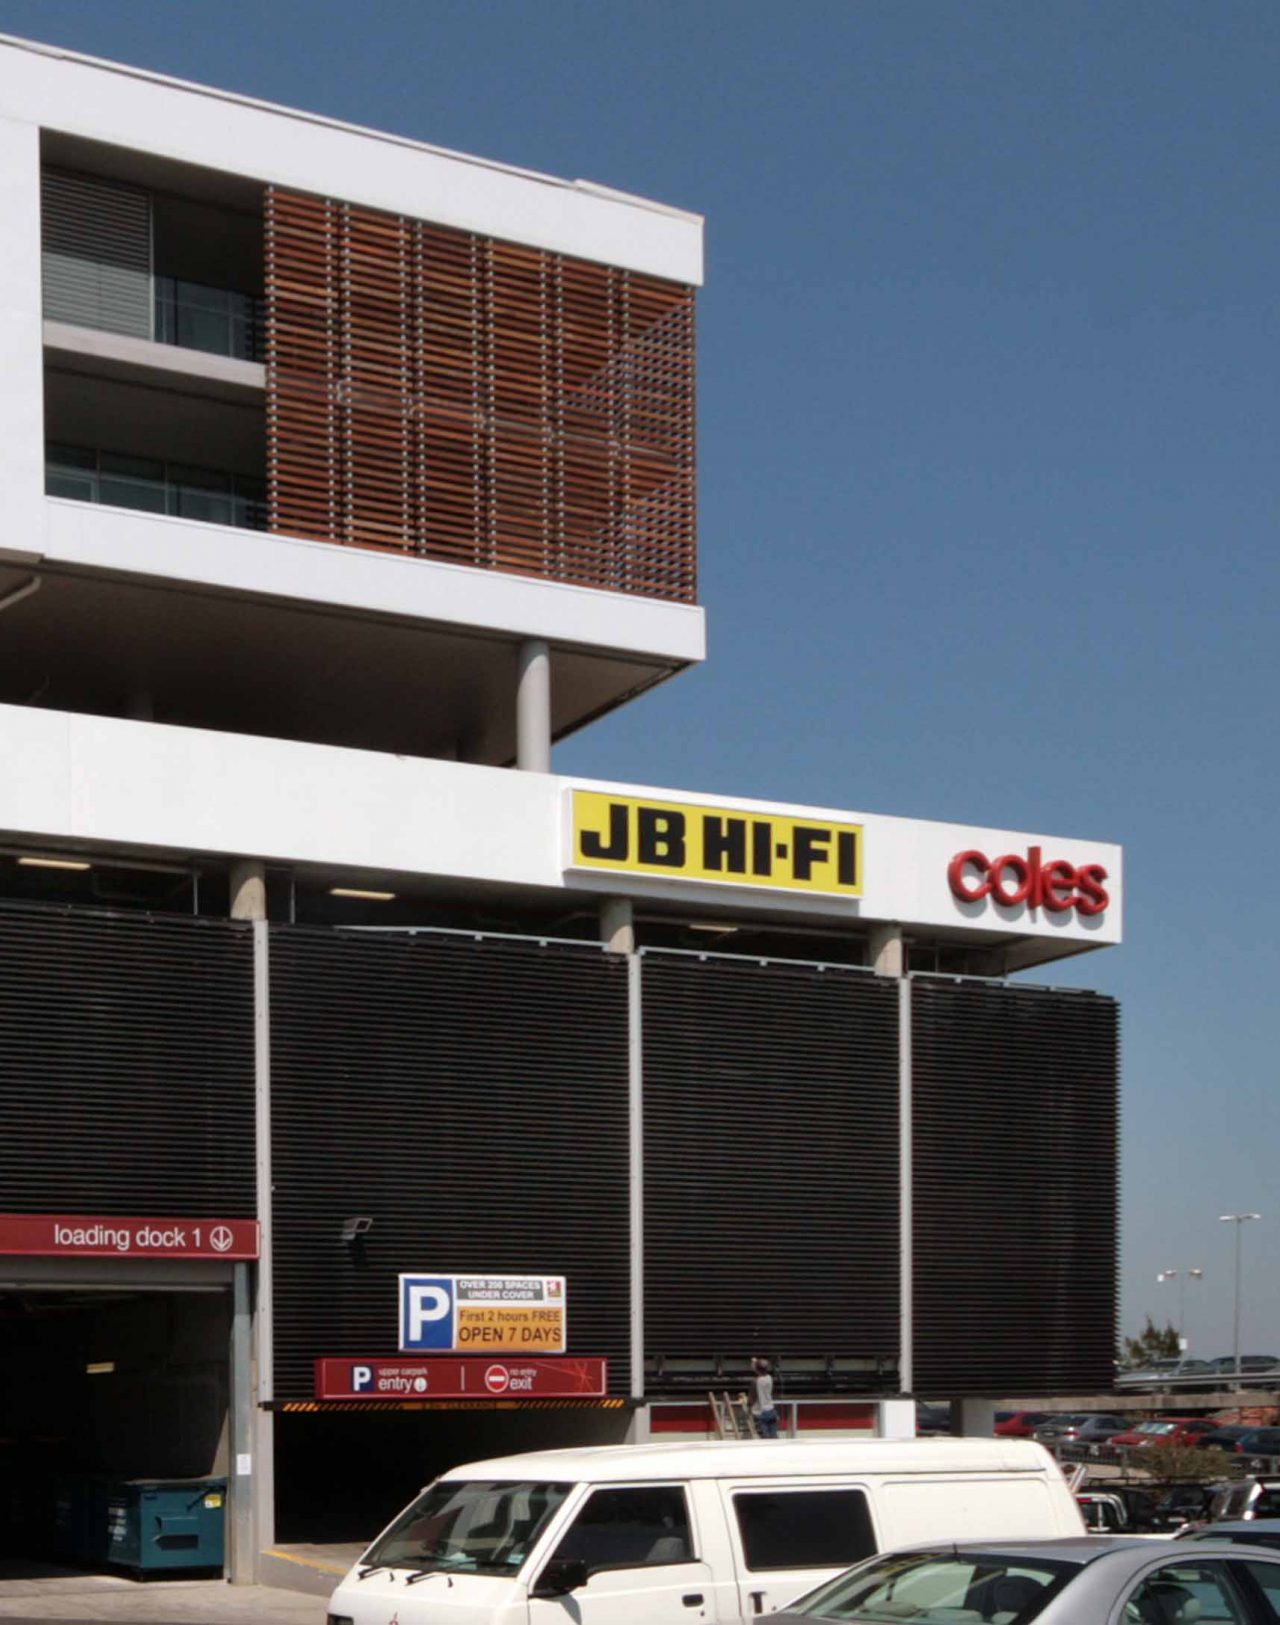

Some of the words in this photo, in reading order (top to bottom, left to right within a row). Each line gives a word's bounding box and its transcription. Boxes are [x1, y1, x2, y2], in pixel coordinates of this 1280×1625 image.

[580, 804, 686, 868] JB
[947, 846, 1109, 916] coles
[54, 1224, 130, 1250] loading
[136, 1226, 186, 1247] dock
[192, 1228, 201, 1247] 1
[460, 1280, 486, 1289] OVER
[504, 1280, 541, 1290] SPACES
[468, 1290, 500, 1299] UNDER
[502, 1290, 534, 1299] COVER
[409, 1286, 450, 1342] P
[460, 1310, 485, 1322] First
[488, 1310, 495, 1322] 2
[497, 1310, 528, 1322] hours
[532, 1311, 560, 1322] FREE
[459, 1326, 504, 1342] OPEN
[508, 1327, 517, 1341] 7
[521, 1326, 562, 1342] DAYS
[353, 1366, 372, 1391] P
[378, 1376, 413, 1394] entry
[509, 1377, 532, 1390] exit
